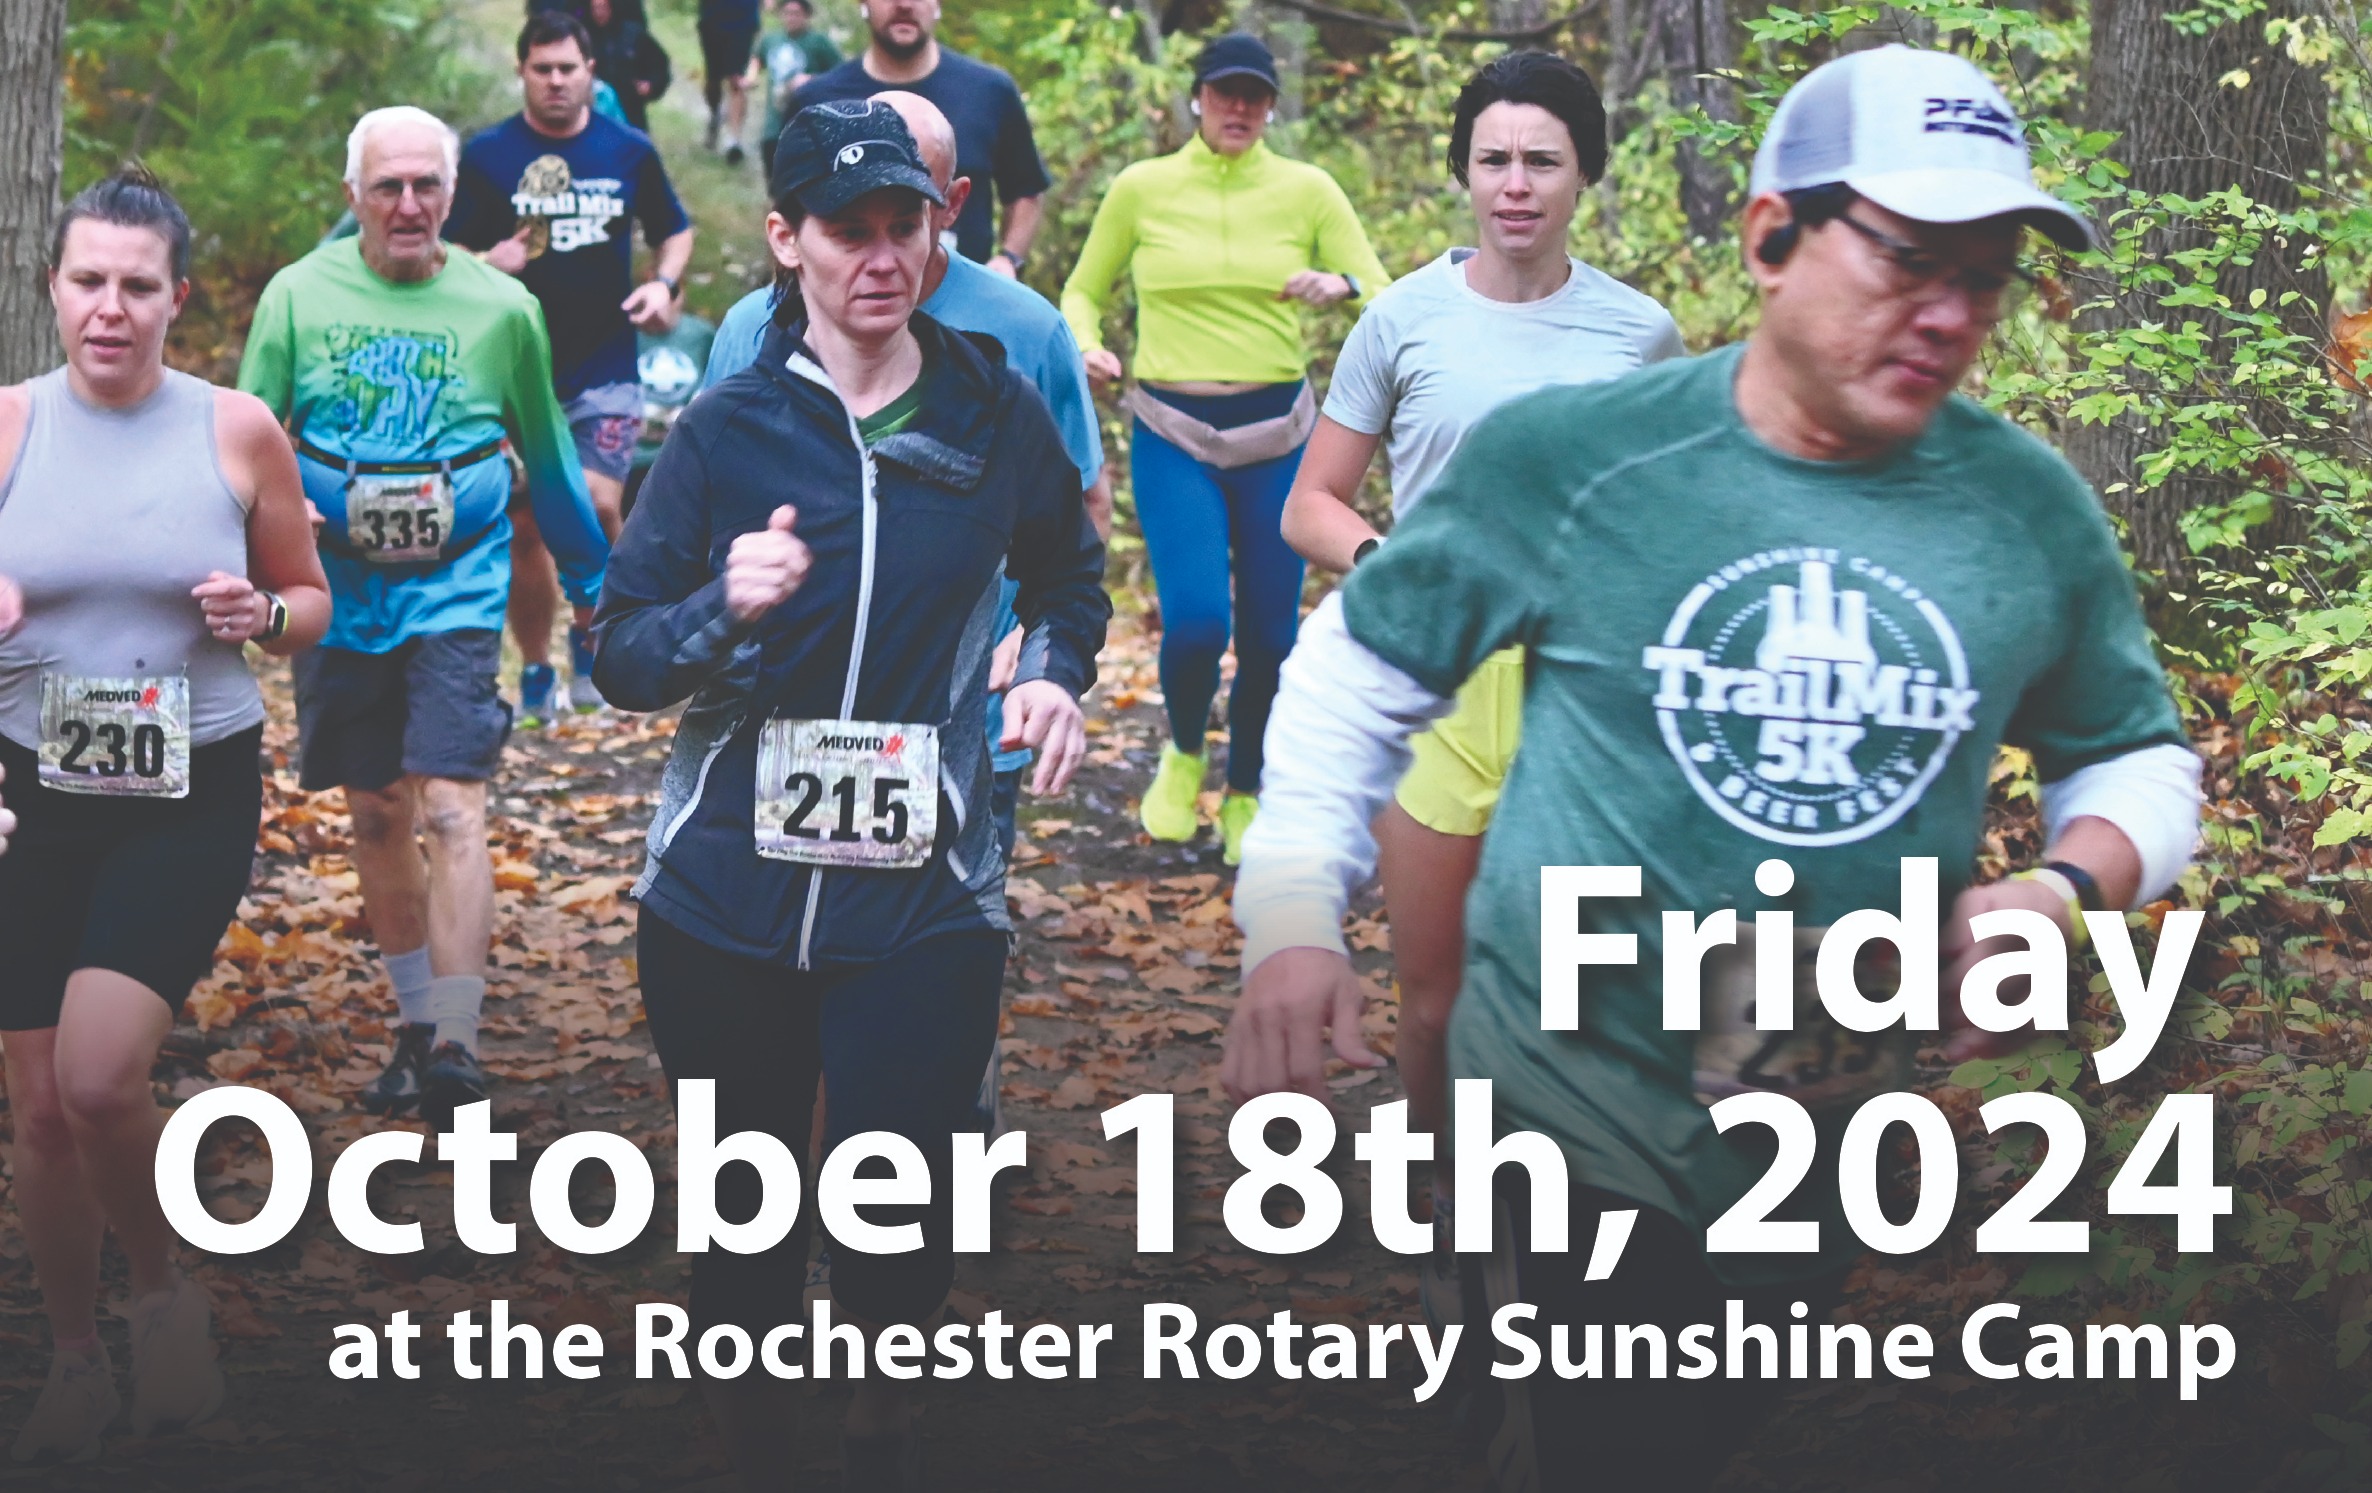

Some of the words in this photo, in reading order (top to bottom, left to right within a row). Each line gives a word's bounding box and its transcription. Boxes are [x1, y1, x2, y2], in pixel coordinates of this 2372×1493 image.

[510, 191, 576, 216] Trail
[551, 216, 611, 251] 5K
[363, 507, 440, 549] 335
[84, 690, 141, 703] MEDVED
[60, 720, 164, 778] 230
[817, 735, 884, 751] MEDVED
[1754, 718, 1866, 786] 5K
[783, 772, 909, 844] 215
[1718, 773, 1819, 828] BEER
